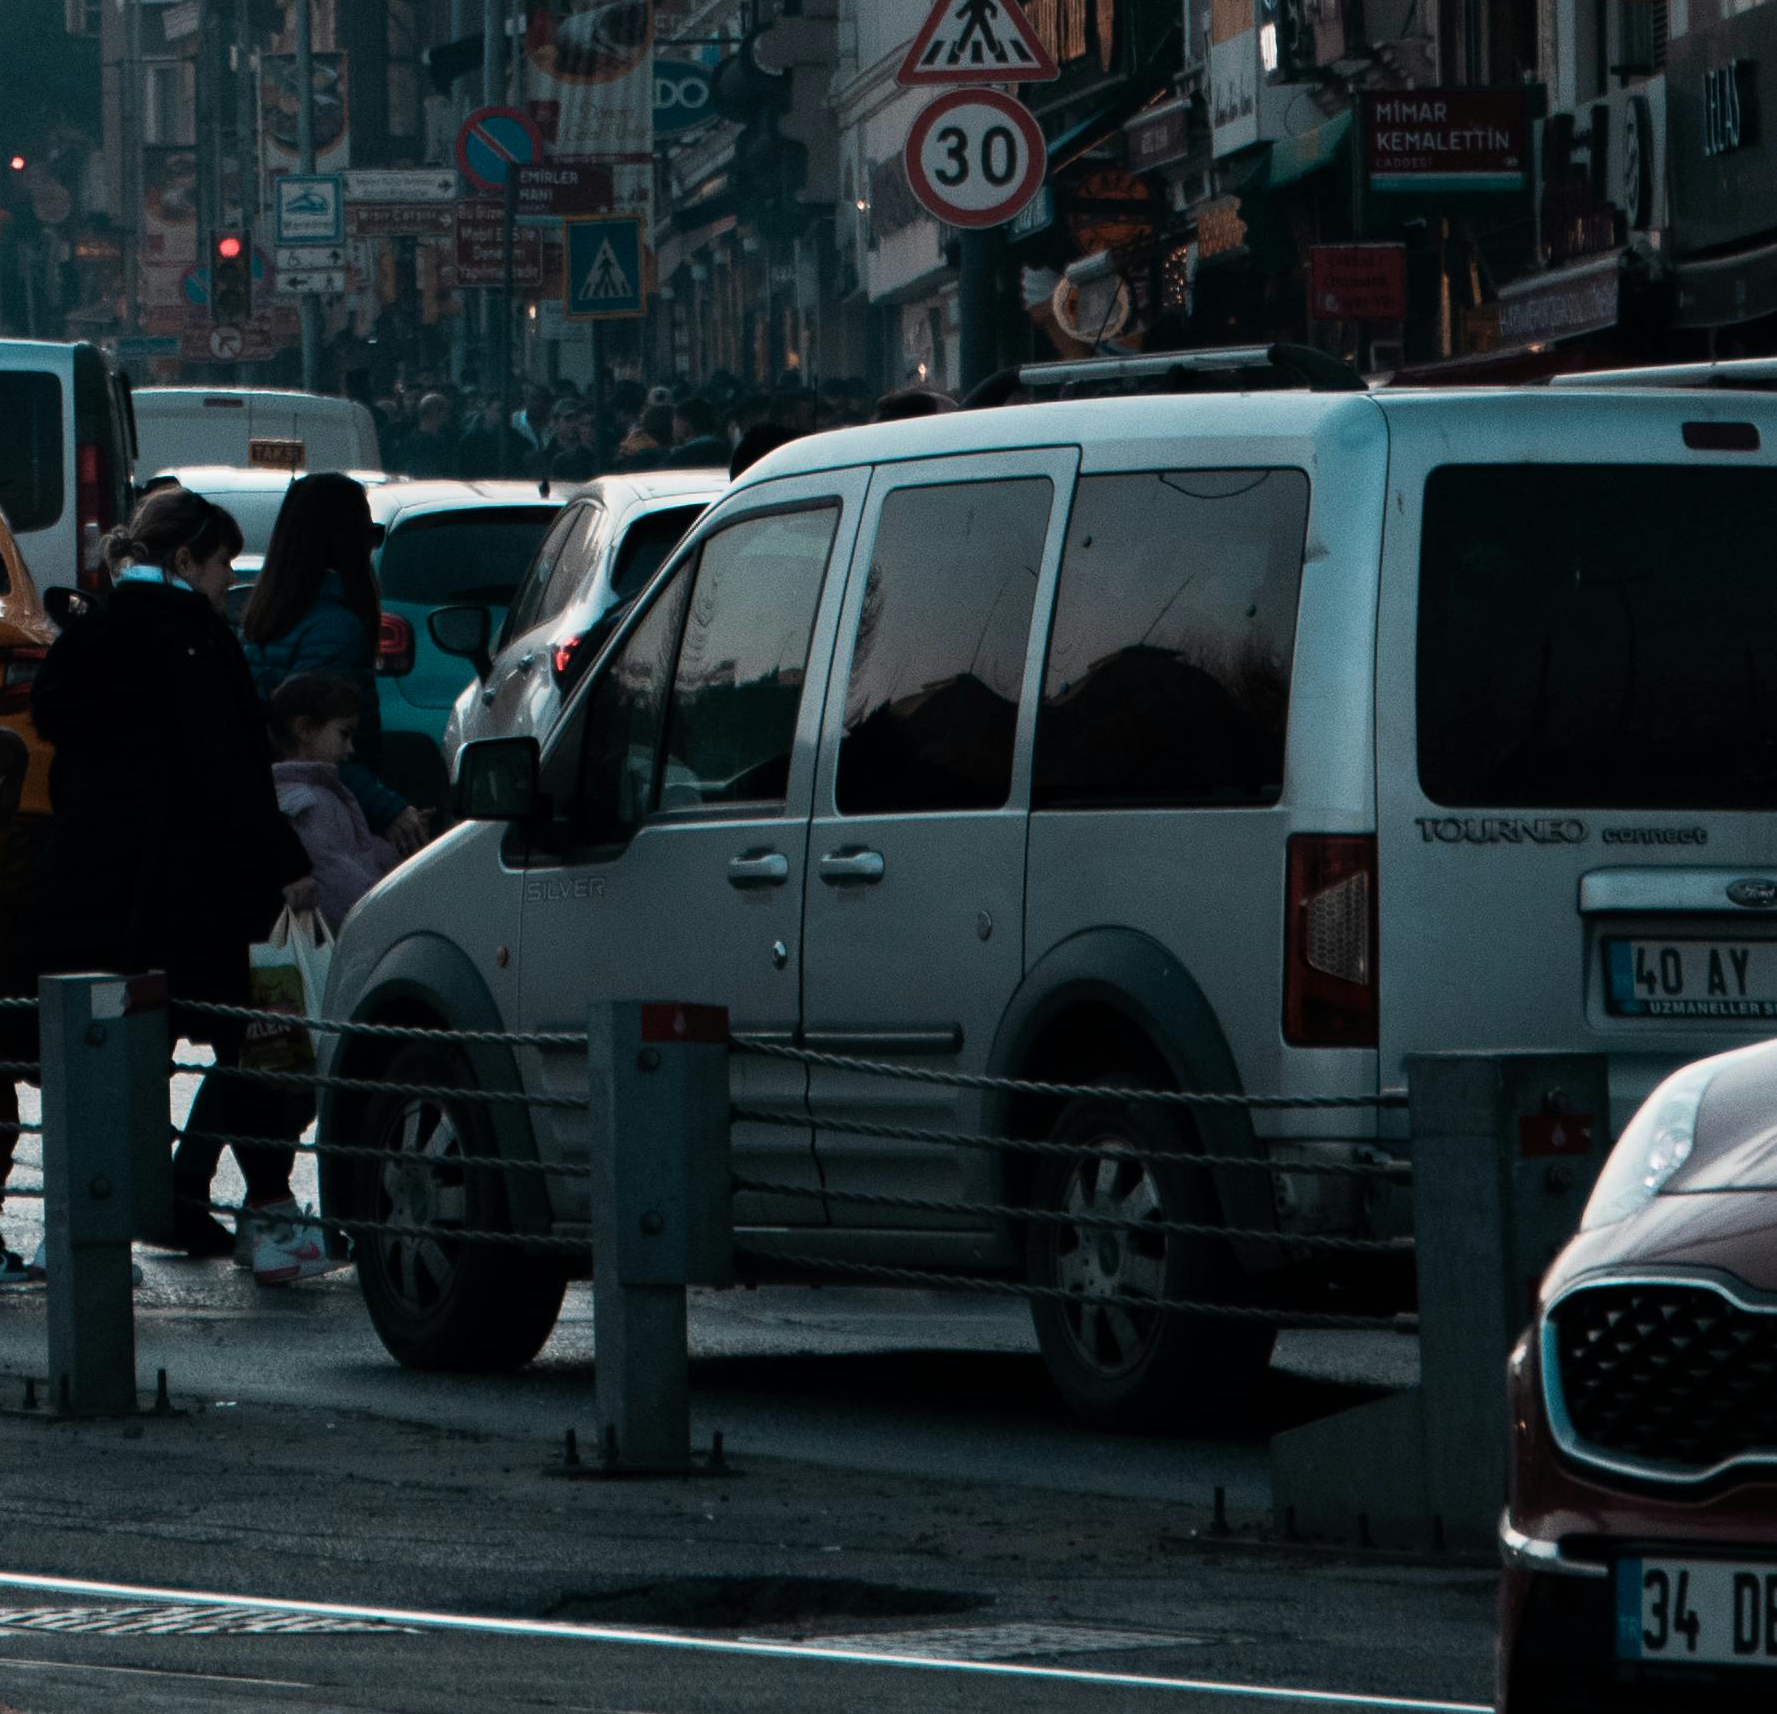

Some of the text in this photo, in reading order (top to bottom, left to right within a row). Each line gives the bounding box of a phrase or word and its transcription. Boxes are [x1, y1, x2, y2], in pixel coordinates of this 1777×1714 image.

[654, 77, 709, 110] DO
[1375, 100, 1448, 123] MİMAR
[1376, 127, 1510, 152] KEMALETTİN
[932, 125, 1018, 188] 30
[1415, 817, 1709, 845] TOURNEO connect
[527, 877, 606, 901] SILVER
[1636, 947, 1750, 995] 40 AY
[1650, 1002, 1760, 1015] UZMANELLER
[1643, 1570, 1699, 1651] 34
